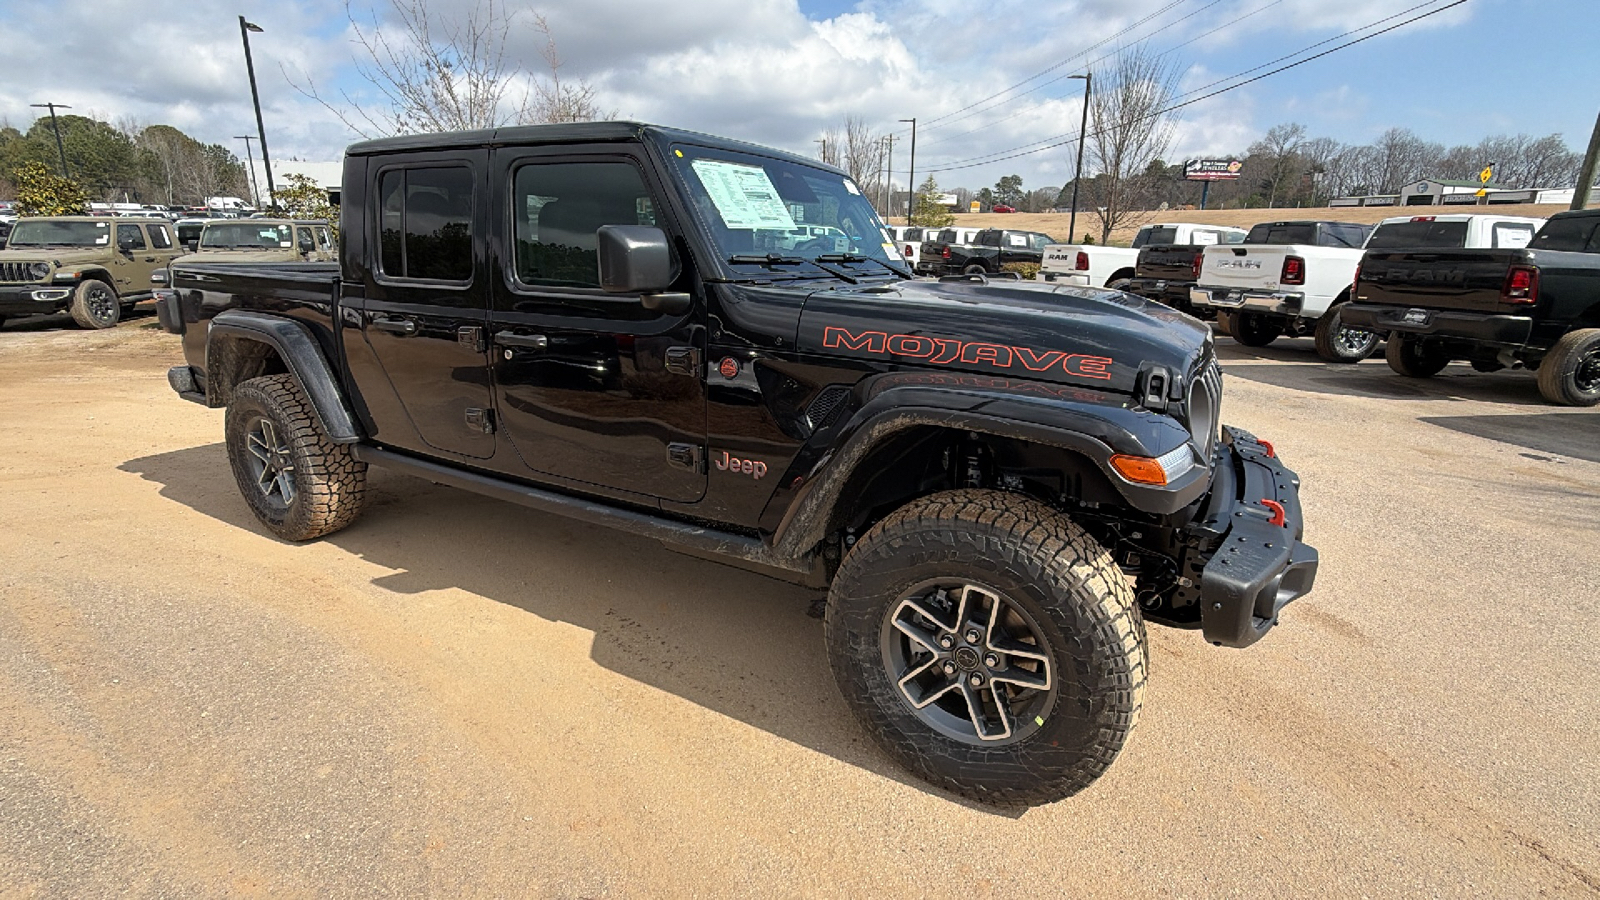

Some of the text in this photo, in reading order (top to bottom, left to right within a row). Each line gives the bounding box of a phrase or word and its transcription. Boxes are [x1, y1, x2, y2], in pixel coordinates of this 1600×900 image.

[1217, 259, 1262, 269] RAM
[1386, 268, 1466, 280] RAM
[823, 326, 1113, 380] MOJAVE
[715, 451, 767, 480] Jeep
